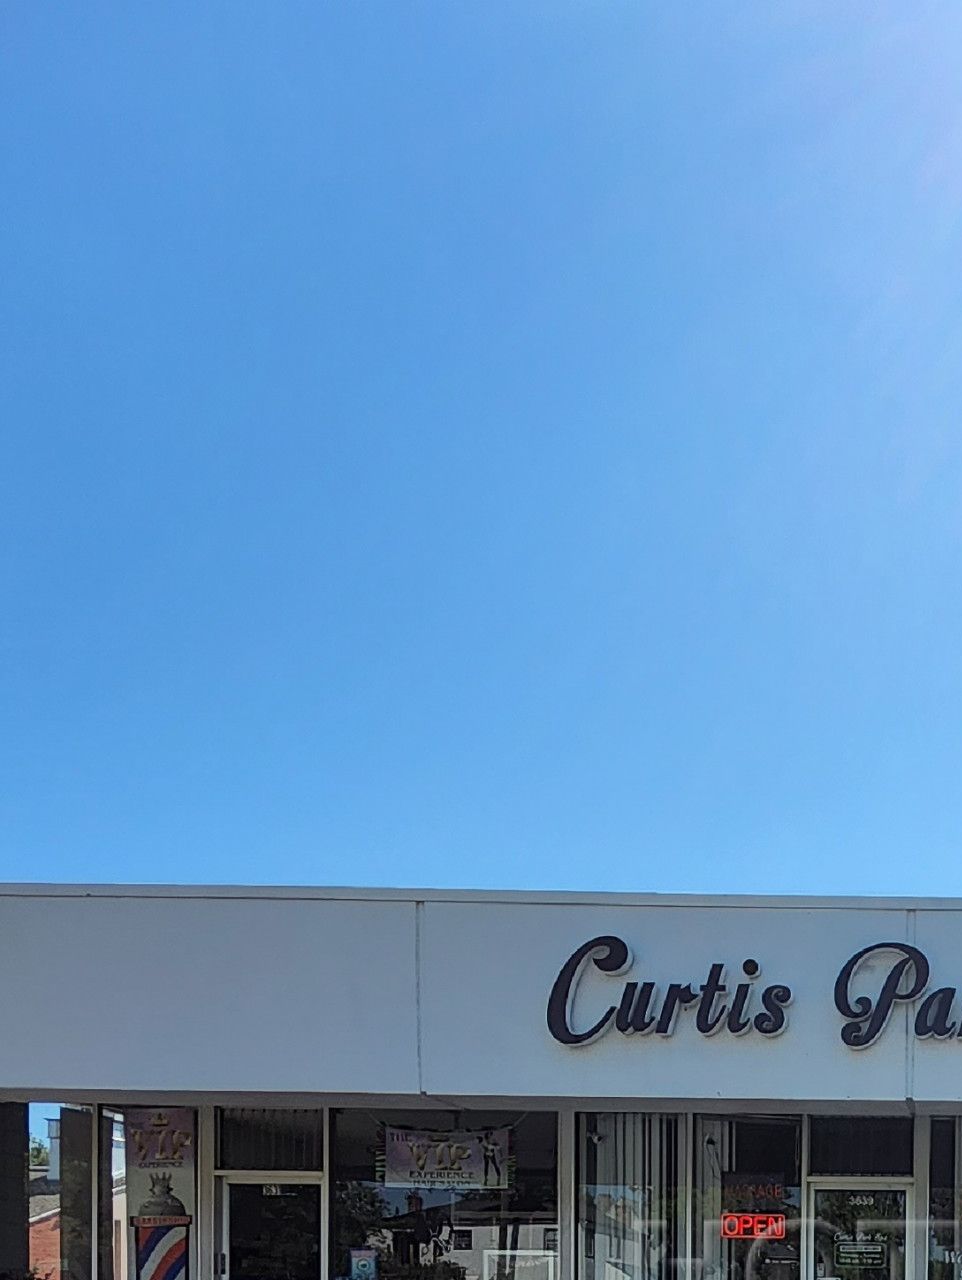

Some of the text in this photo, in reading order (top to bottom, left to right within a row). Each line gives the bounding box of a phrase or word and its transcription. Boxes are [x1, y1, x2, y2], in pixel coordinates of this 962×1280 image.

[546, 935, 792, 1047] Curtis
[406, 1141, 473, 1171] VIP
[409, 1171, 474, 1179] EXPERIENCE
[724, 1215, 783, 1236] OPEN
